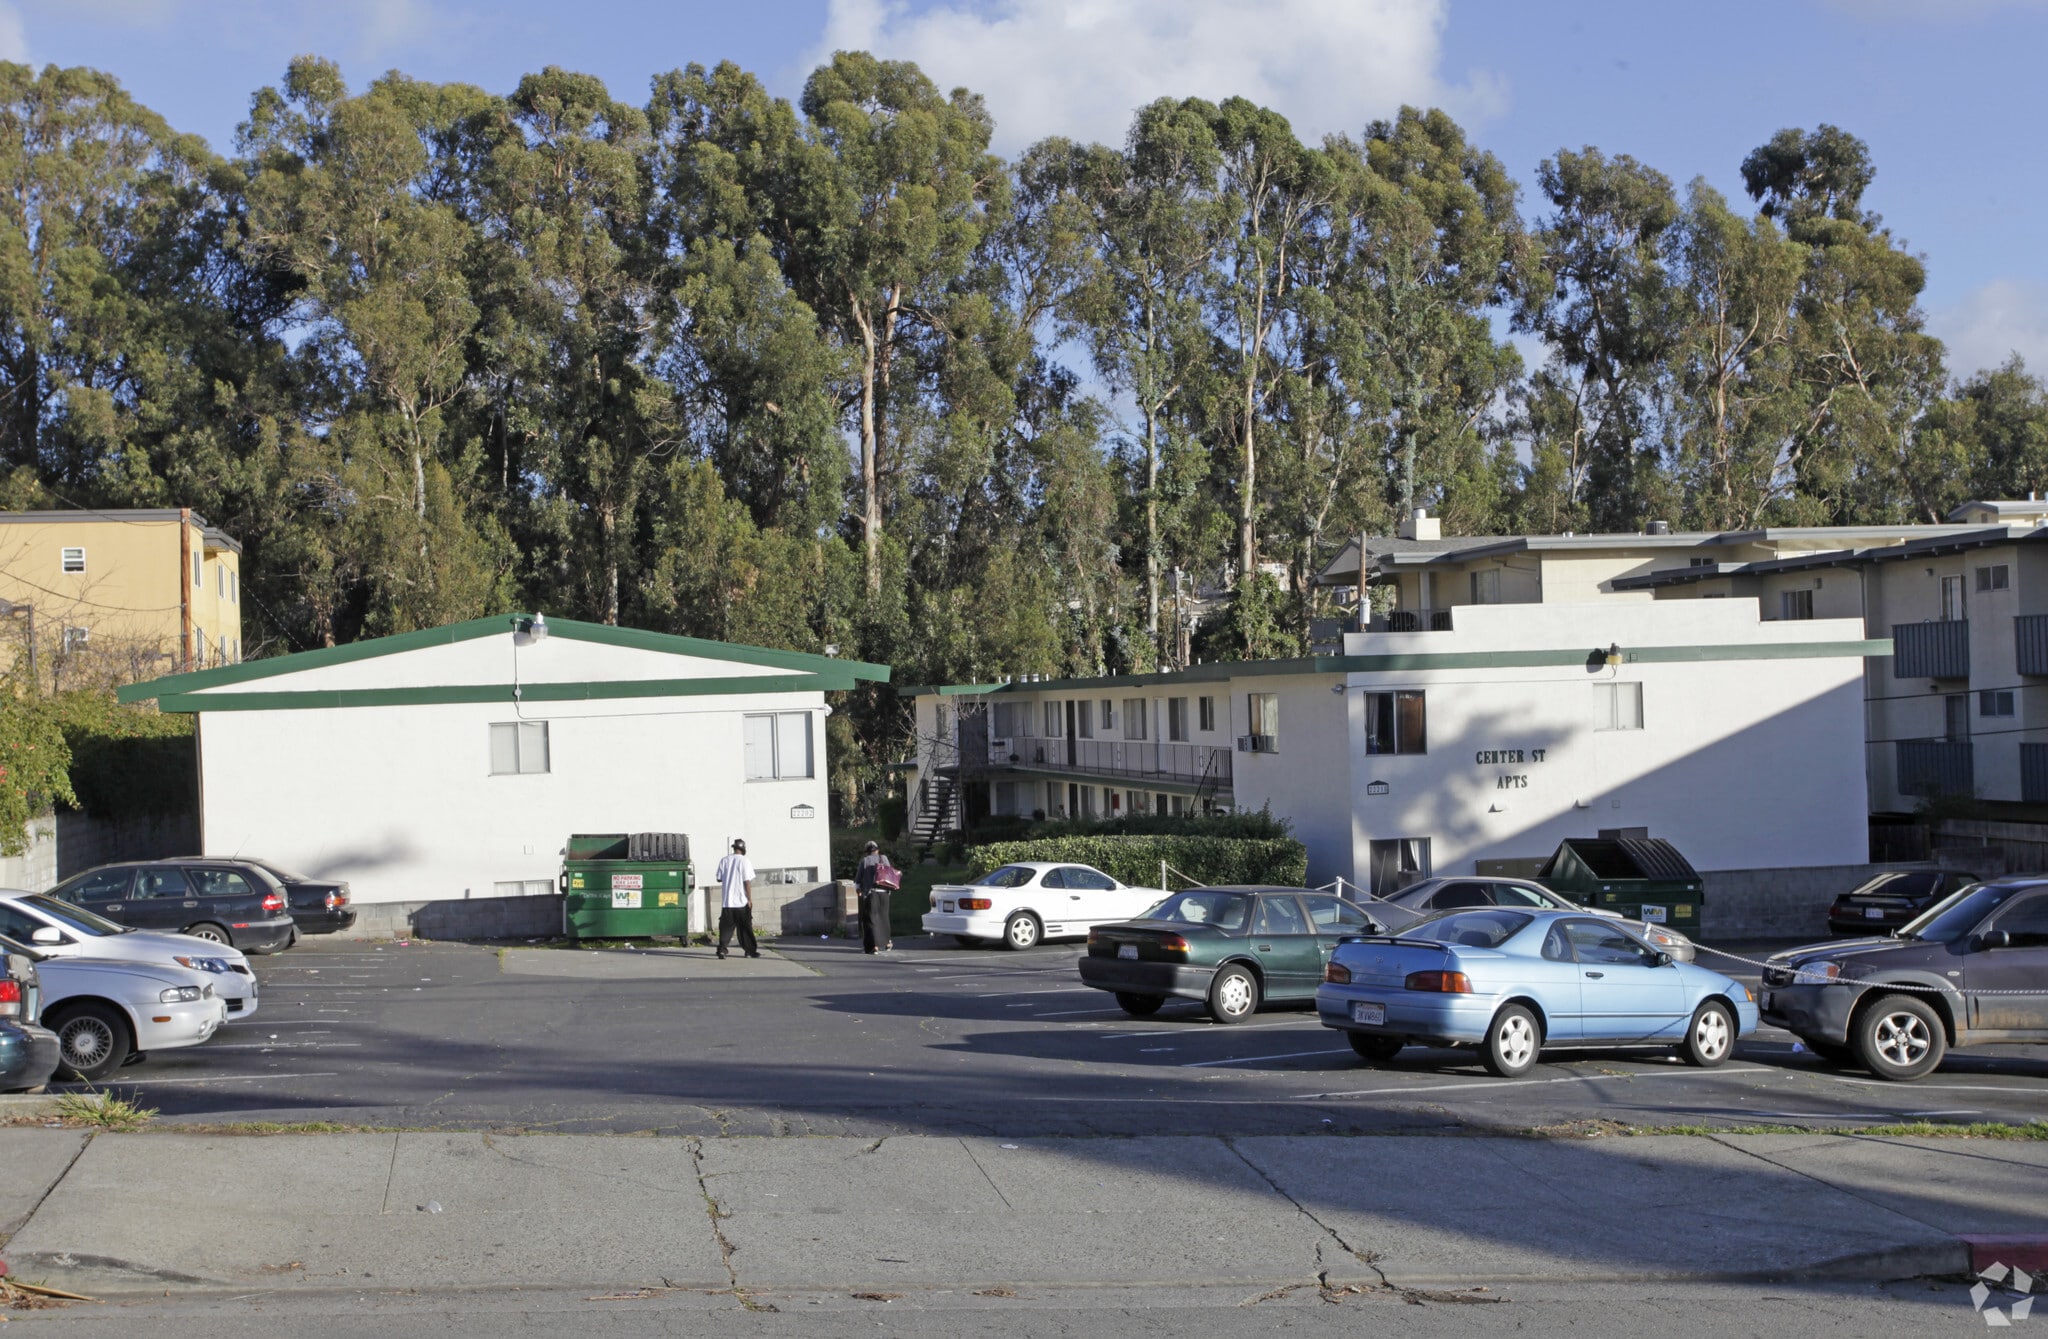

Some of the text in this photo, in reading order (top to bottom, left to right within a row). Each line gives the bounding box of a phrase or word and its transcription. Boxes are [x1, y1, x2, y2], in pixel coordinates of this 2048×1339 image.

[1476, 748, 1546, 765] CENTER ST
[1496, 774, 1528, 789] APTS
[1643, 908, 1663, 916] WM
